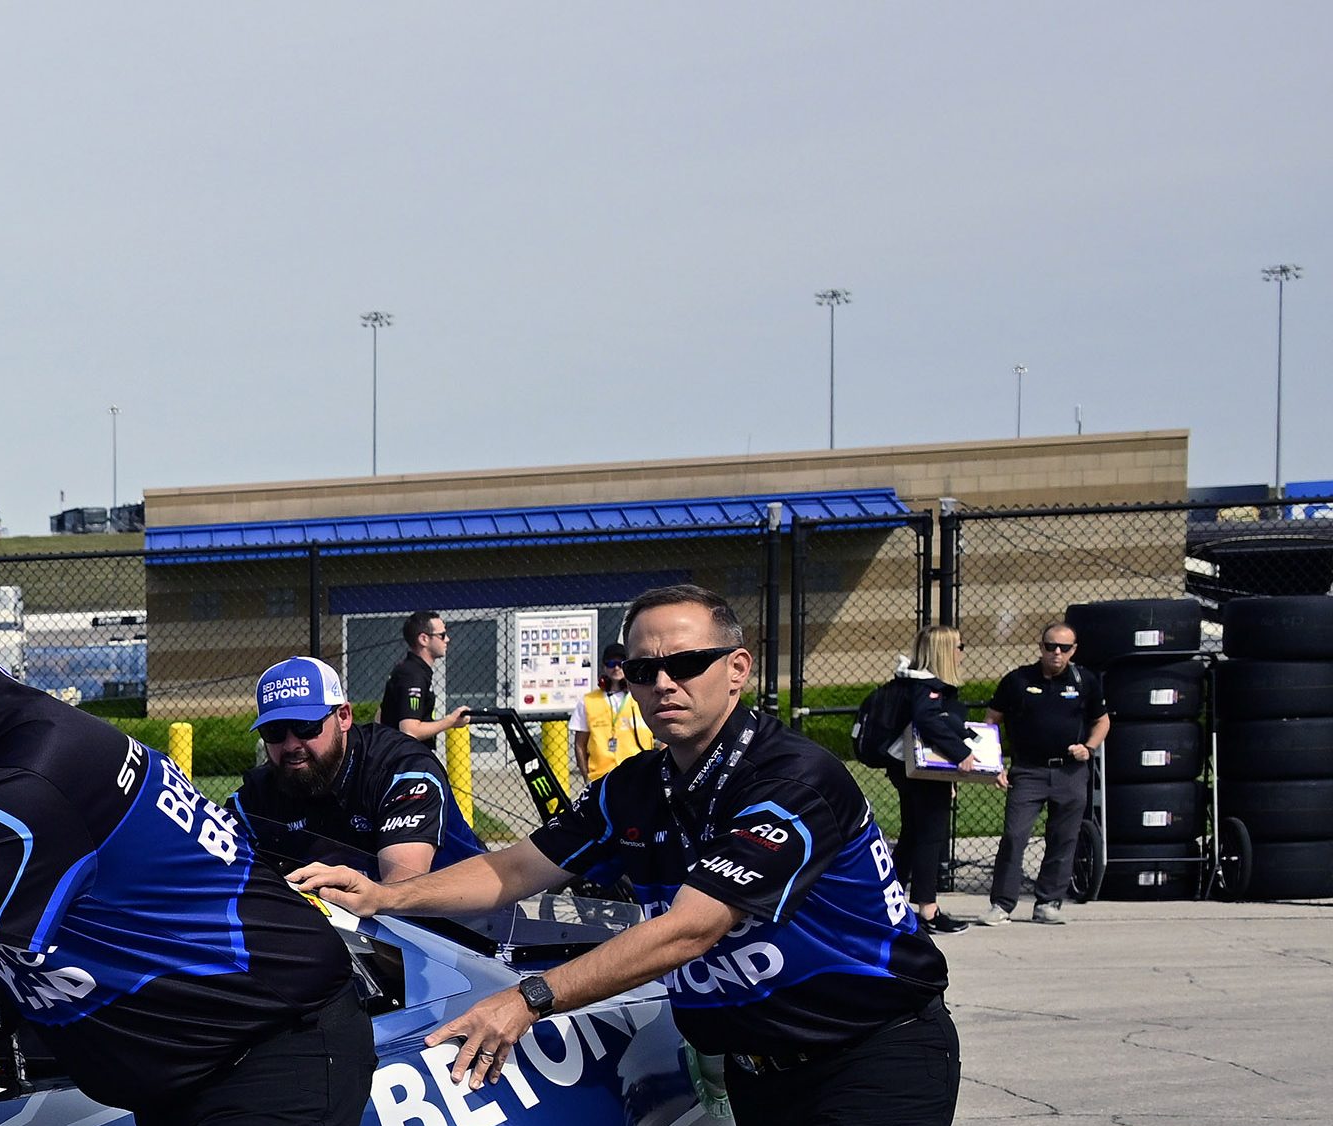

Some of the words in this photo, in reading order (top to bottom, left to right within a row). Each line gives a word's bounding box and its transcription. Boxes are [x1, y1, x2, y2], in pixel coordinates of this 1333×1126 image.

[276, 677, 301, 689] BATH
[263, 686, 310, 704] BEYOND
[687, 742, 724, 792] STEWART
[380, 814, 426, 832] HAAS
[700, 856, 764, 886] HAAS
